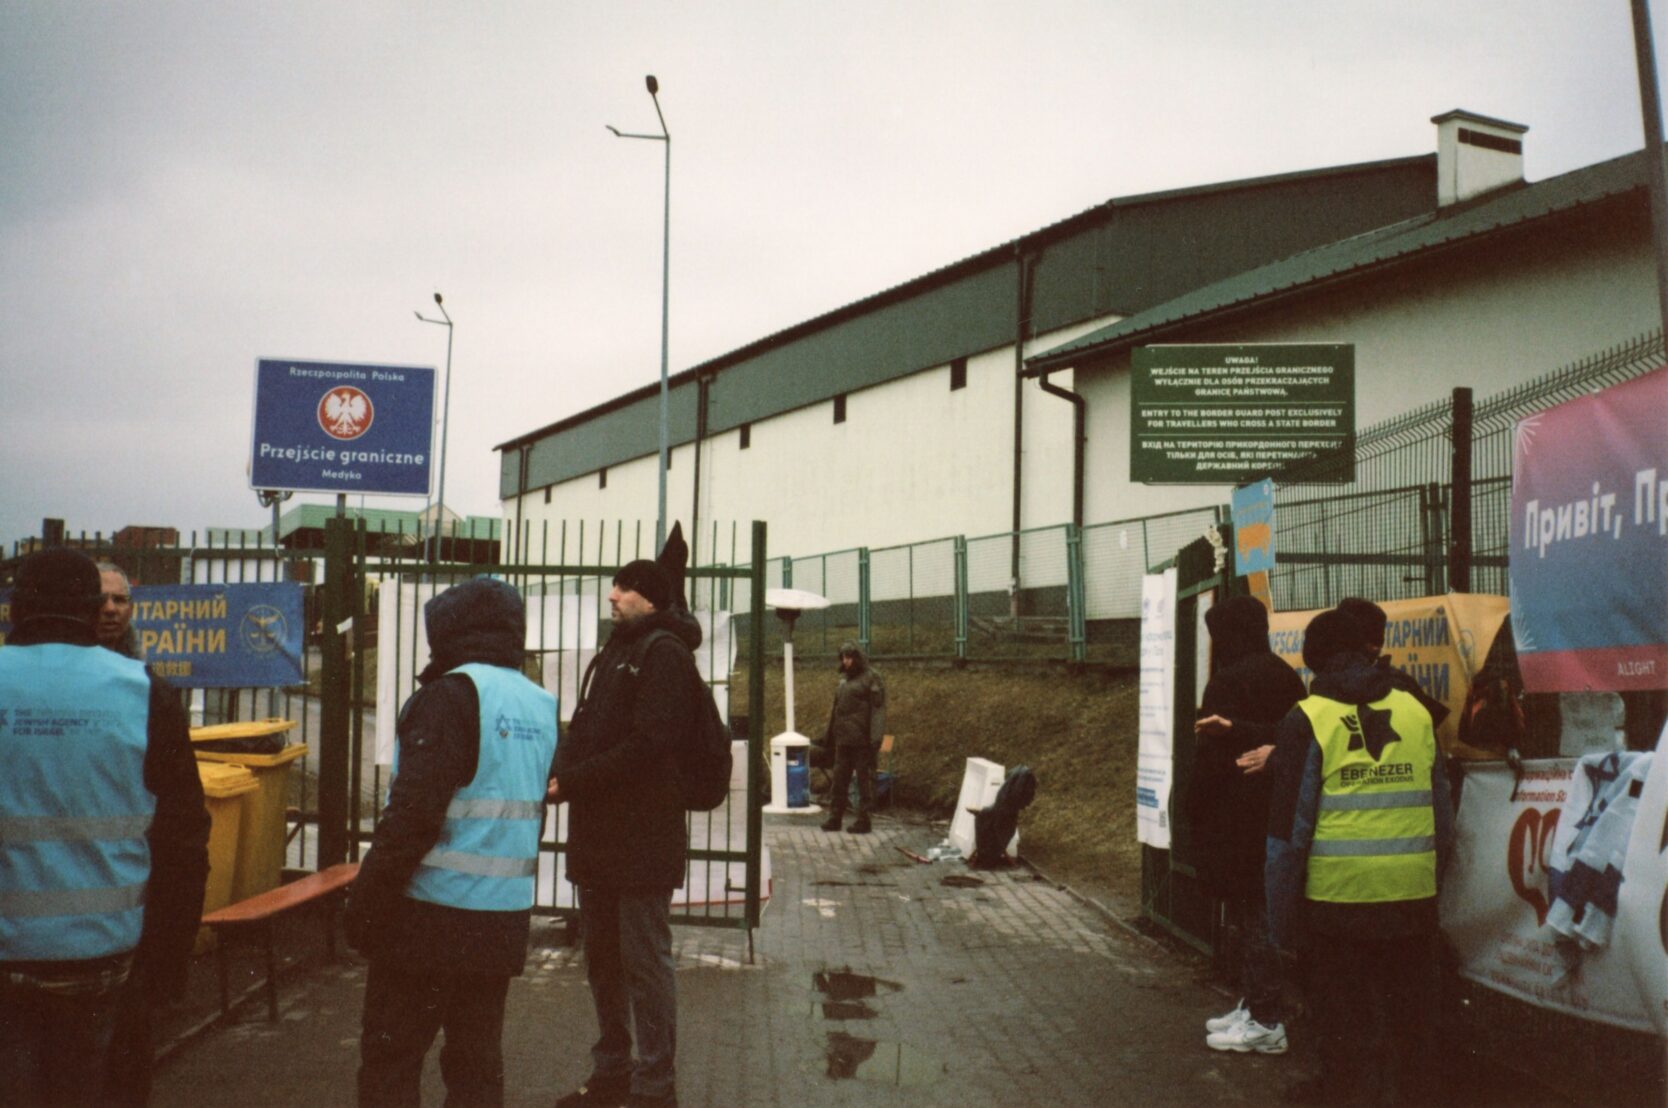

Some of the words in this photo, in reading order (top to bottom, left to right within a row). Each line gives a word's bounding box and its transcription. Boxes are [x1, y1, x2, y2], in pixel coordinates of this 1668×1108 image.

[1224, 356, 1258, 365] UWAGA!
[289, 366, 366, 380] Rzeczpospolita
[371, 371, 406, 383] Polska
[1150, 365, 1186, 375] WEJŚCIE
[1188, 367, 1200, 375] NA
[1201, 367, 1228, 375] TEREN
[1230, 365, 1274, 375] PRZEJŚCIA
[1275, 365, 1334, 374] GRANICZNEGO
[1154, 377, 1202, 388] WYŁĄCZNIE
[1221, 375, 1244, 385] OSÓB
[1245, 377, 1330, 386] PRZEKRACZAJĄCYCH
[1194, 388, 1232, 397] GRANICĘ
[1141, 409, 1169, 418] ENTRY
[1171, 409, 1182, 417] TO
[1183, 409, 1199, 417] THE
[1200, 409, 1233, 417] BORDER
[1234, 408, 1264, 417] GUARD
[1265, 408, 1286, 417] POST
[1287, 408, 1343, 417] EXCLUSIVELY
[1147, 420, 1164, 428] FOR
[1165, 419, 1218, 428] TRAVELLERS
[1218, 419, 1239, 427] WHO
[1240, 419, 1267, 427] CROSS
[1267, 419, 1275, 427] A
[1275, 419, 1301, 427] STATE
[1302, 419, 1337, 427] BORDER
[1141, 441, 1162, 449] ВХІД
[1177, 441, 1224, 449] ТЕРИТОРІЮ
[1225, 440, 1297, 450] ПРИКОРДОННОГО
[260, 443, 336, 464] Przejście
[340, 448, 425, 466] graniczne
[1166, 451, 1196, 459] ТІЛЬКИ
[1197, 451, 1215, 460] ДЛЯ
[1240, 451, 1254, 459] ЯКІ
[1195, 460, 1250, 470] ДЕРЖАВНИЙ
[321, 469, 362, 481] Medyka
[1524, 481, 1622, 558] Привіт,
[1617, 660, 1656, 675] ALIGHT
[1340, 763, 1413, 780] EBENEZER
